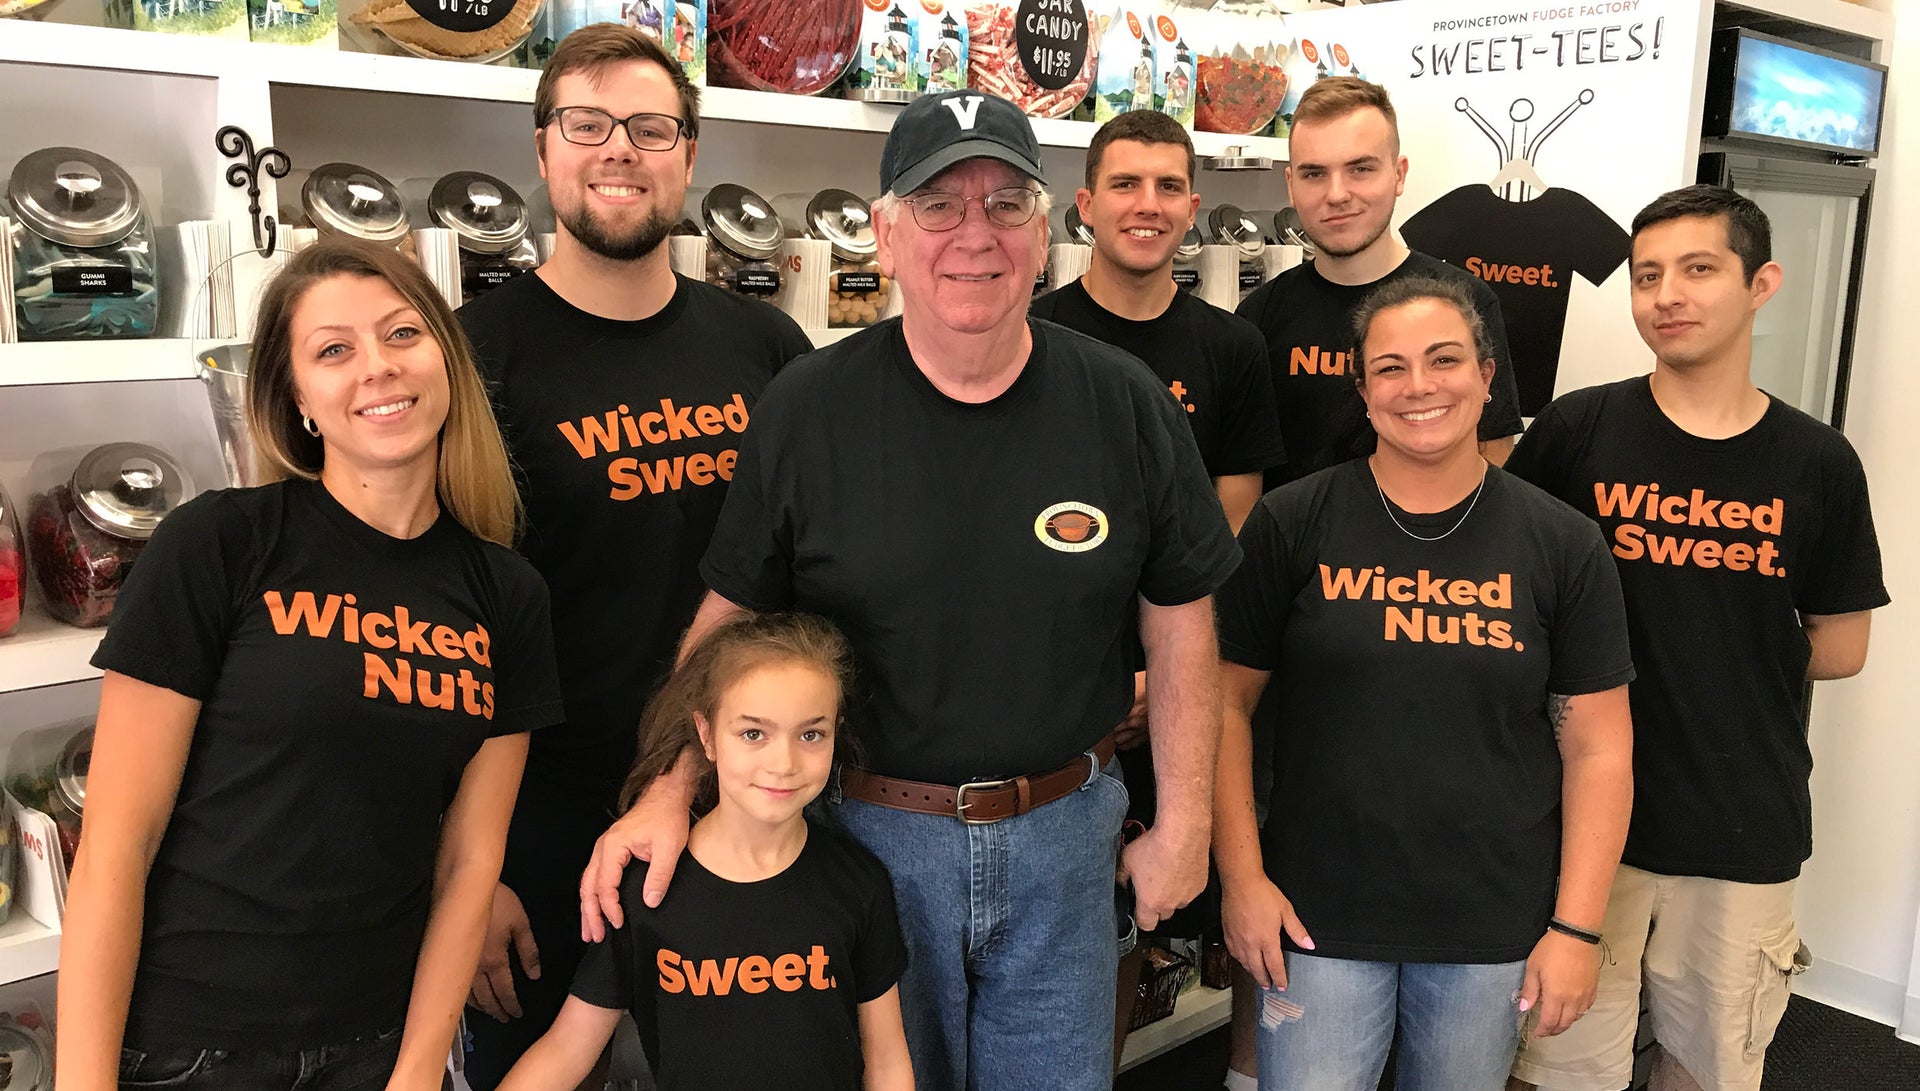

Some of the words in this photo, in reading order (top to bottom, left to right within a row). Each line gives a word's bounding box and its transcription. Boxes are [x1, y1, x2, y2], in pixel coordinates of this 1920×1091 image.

[1026, 13, 1082, 41] CANDY
[1433, 12, 1528, 32] PROVINCETOWN
[1533, 6, 1575, 22] FUDGE
[1580, 0, 1640, 17] FACTORY
[1033, 45, 1071, 75] $11.95
[1410, 16, 1665, 79] SWEET-TEES!
[941, 96, 985, 131] V
[1465, 256, 1558, 288] Sweet.
[556, 393, 750, 460] Wicked
[1594, 482, 1784, 536] Wicked
[1612, 523, 1787, 578] Sweet.
[1318, 563, 1512, 610] Wicked
[263, 590, 491, 669] Wicked
[1384, 606, 1525, 652] Nuts.
[363, 652, 495, 721] Nuts
[656, 945, 837, 996] Sweet.
